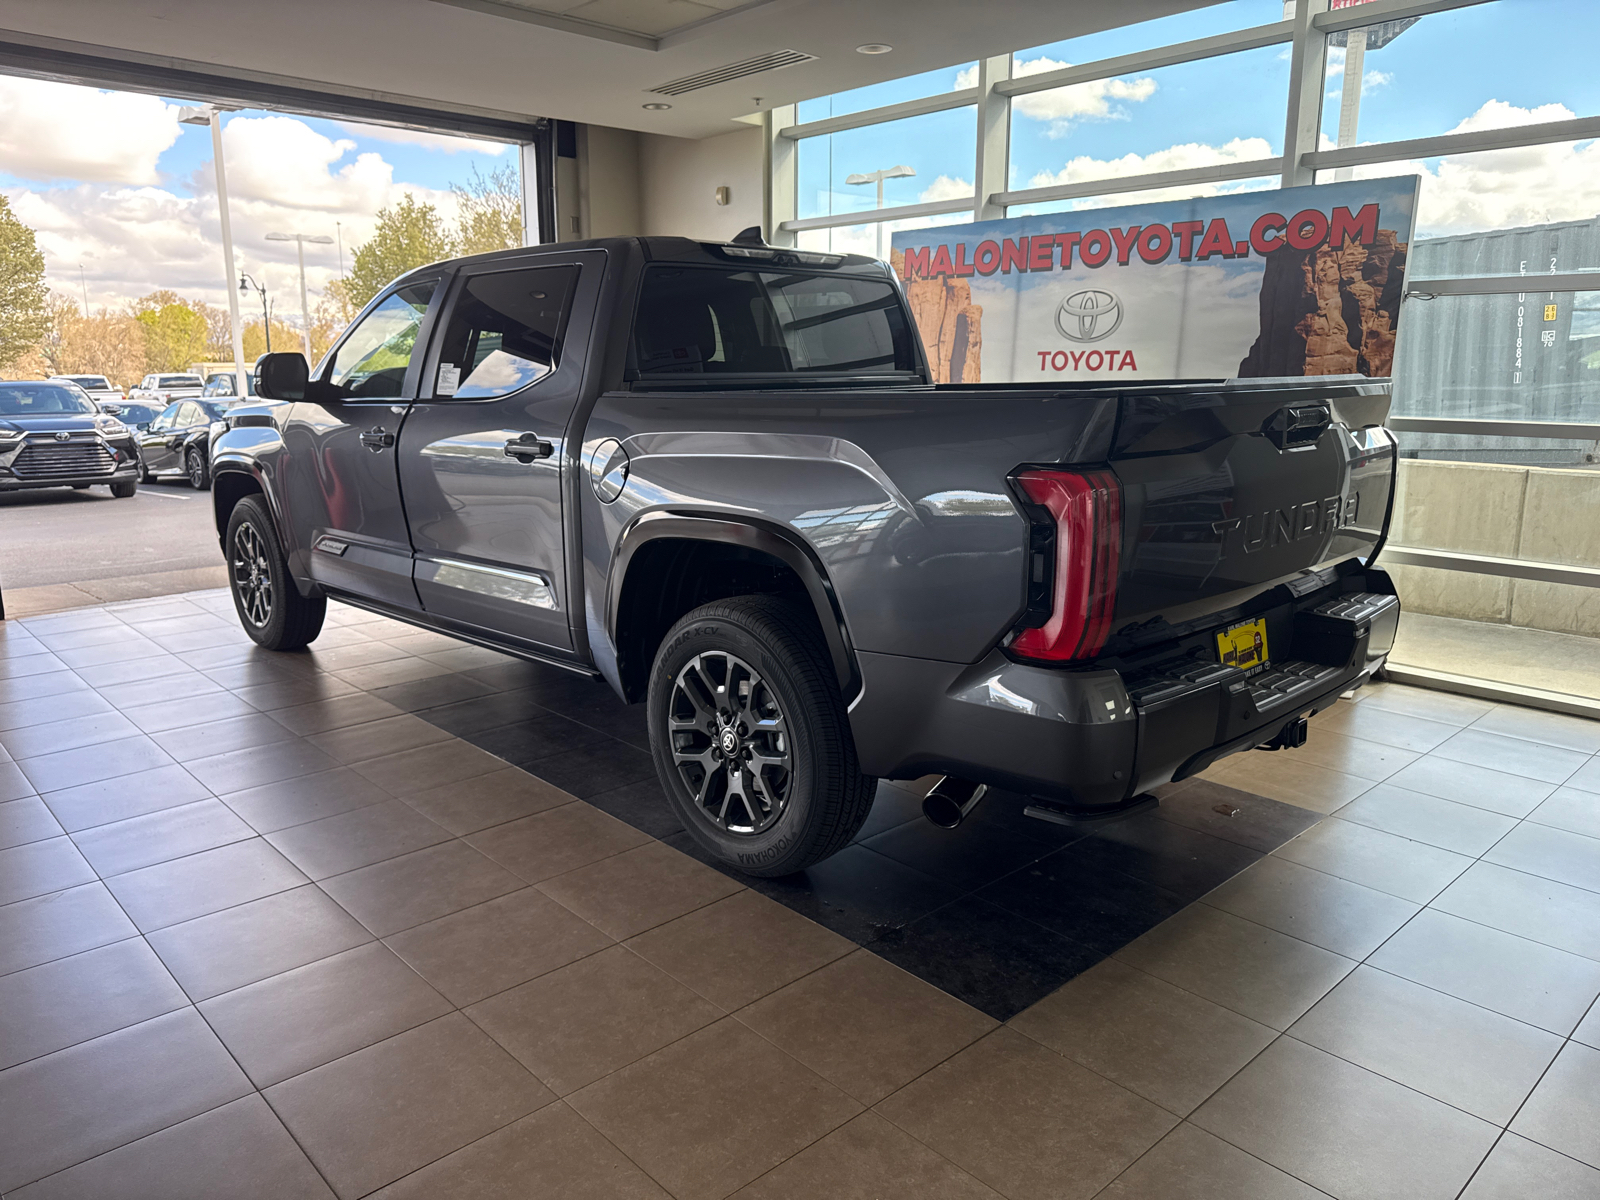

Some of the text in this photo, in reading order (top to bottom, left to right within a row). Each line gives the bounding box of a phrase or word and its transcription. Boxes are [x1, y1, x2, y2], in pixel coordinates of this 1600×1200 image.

[904, 203, 1380, 281] MALONETOYOTA.COM
[1038, 350, 1137, 372] TOYOTA
[1211, 491, 1359, 560] TUNDRA
[737, 835, 791, 864] YOKOHAMA
